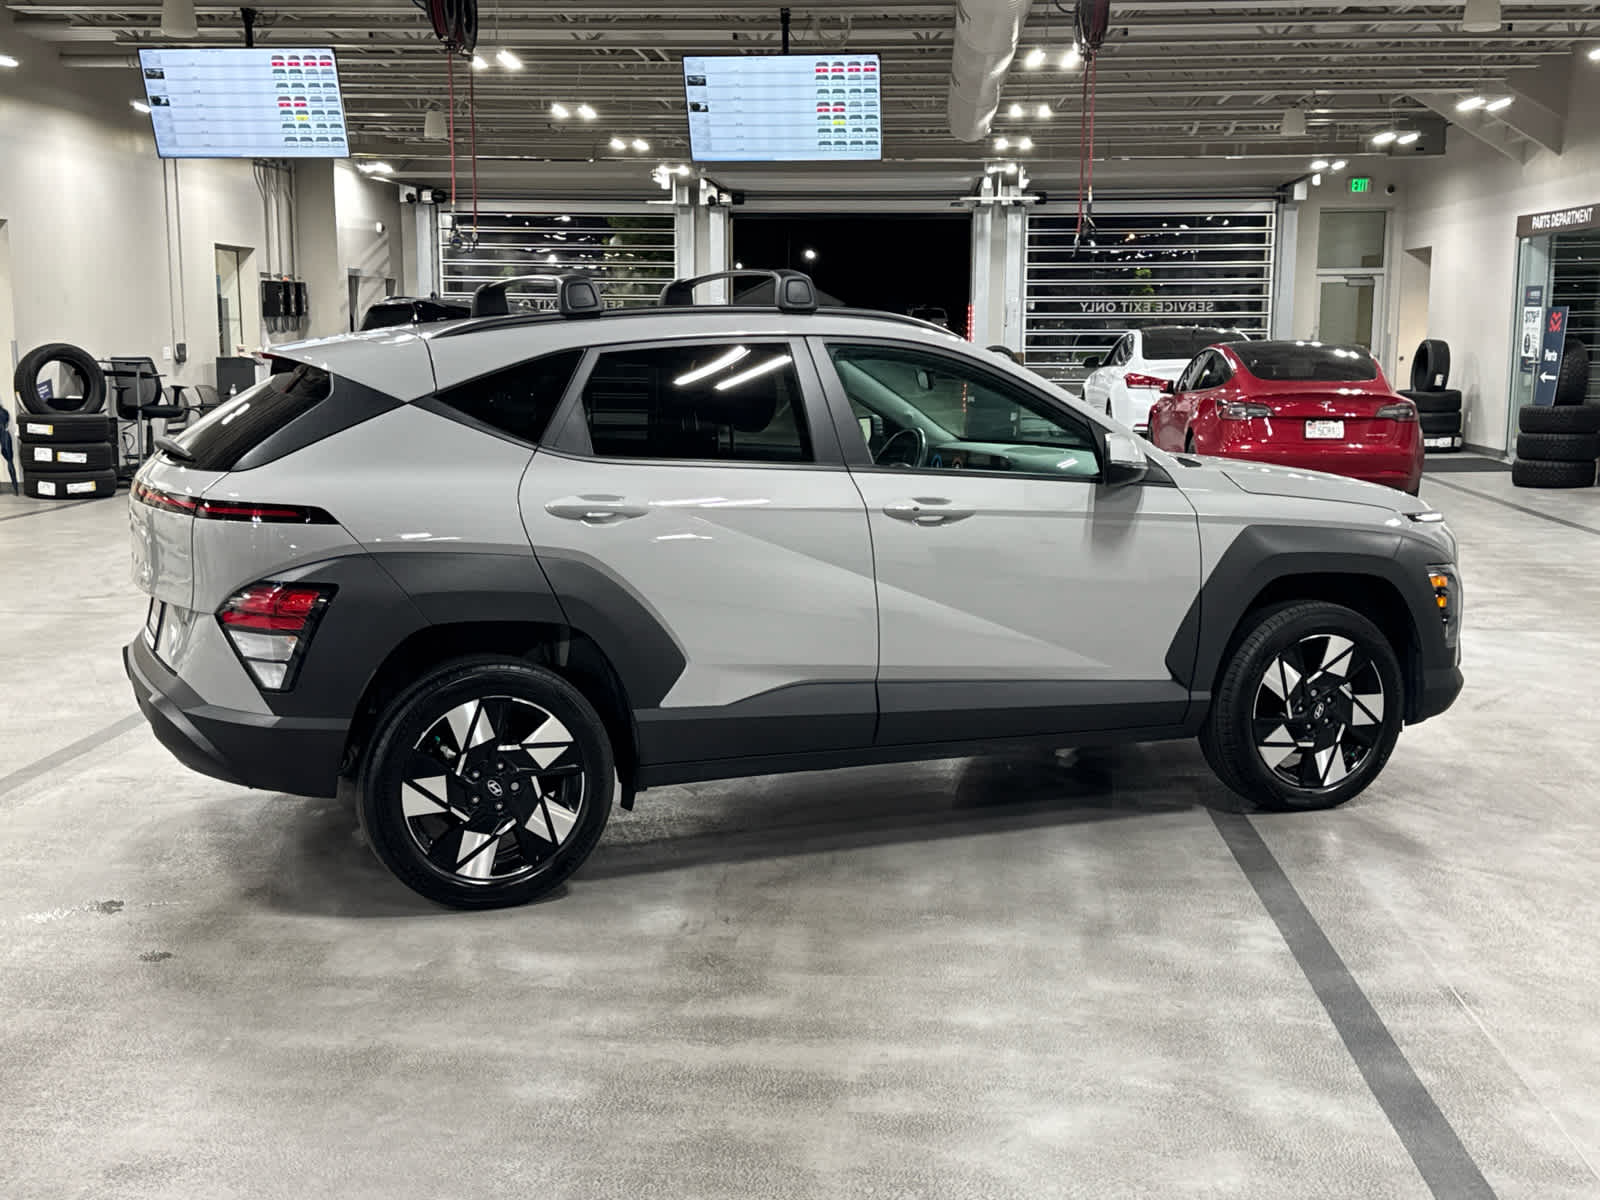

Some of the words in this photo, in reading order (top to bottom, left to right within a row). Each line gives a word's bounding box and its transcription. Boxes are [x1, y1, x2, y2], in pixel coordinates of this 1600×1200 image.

[1352, 178, 1368, 192] EXIT
[1532, 214, 1551, 230] PARTS
[1551, 207, 1593, 228] DEPARTMENT
